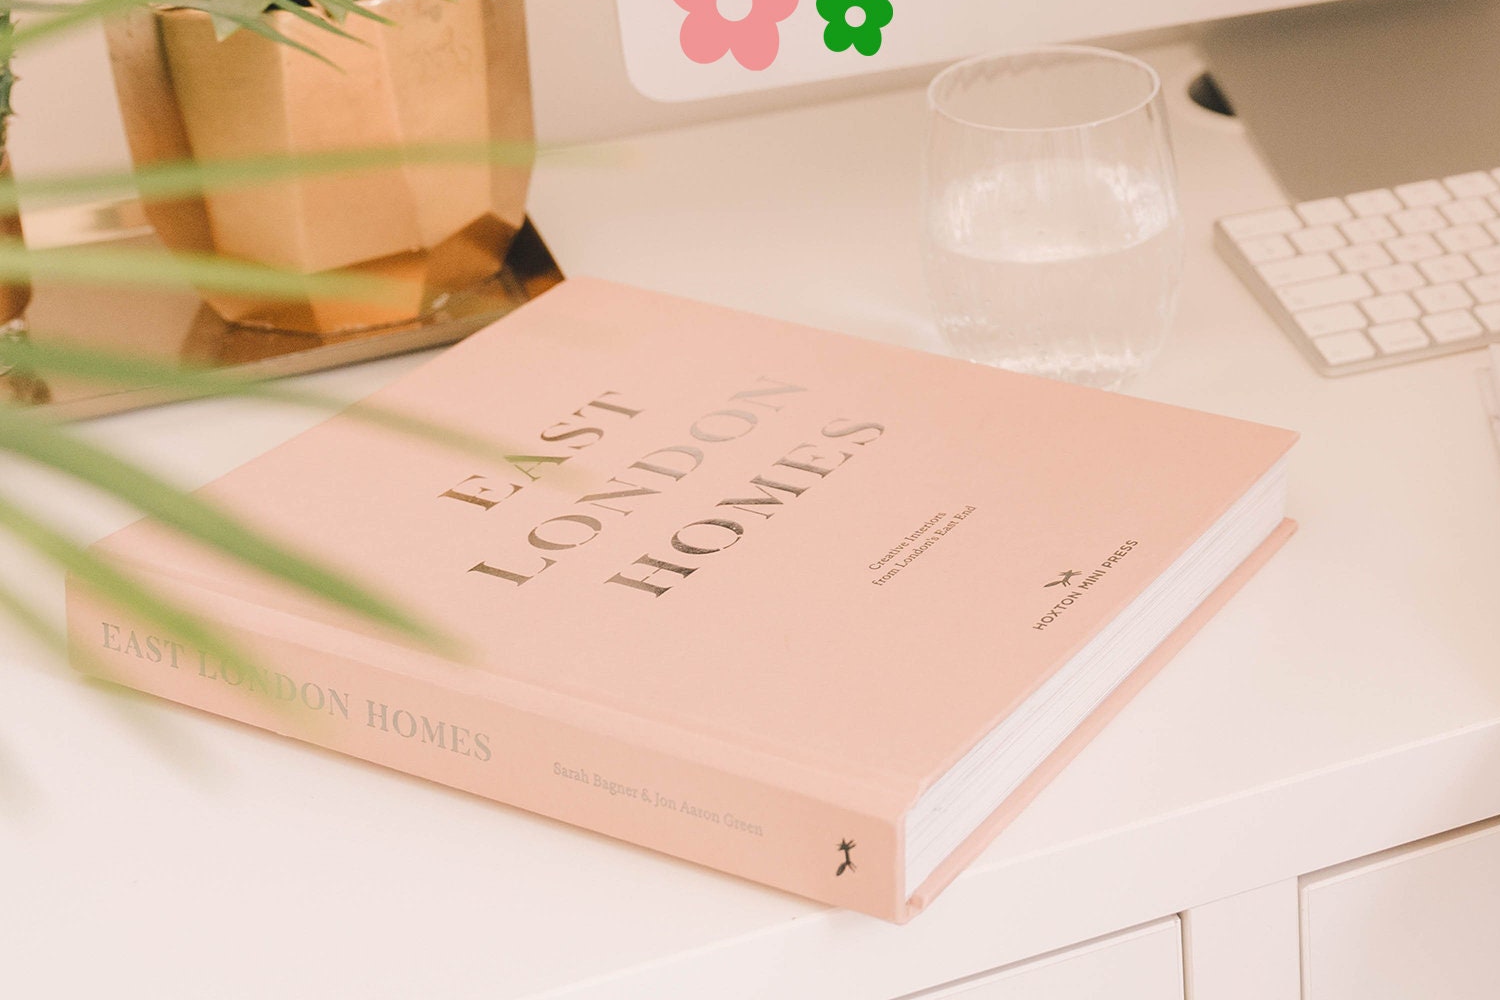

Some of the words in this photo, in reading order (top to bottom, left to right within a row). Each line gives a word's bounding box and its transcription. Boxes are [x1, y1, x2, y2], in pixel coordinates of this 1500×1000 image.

[438, 391, 644, 511] EAST
[468, 375, 808, 587] LONDON
[604, 417, 885, 598] HOMES
[868, 541, 910, 571] Creative
[904, 512, 947, 542] Interiors
[871, 568, 900, 586] from
[934, 520, 959, 536] East
[953, 505, 977, 520] End
[1032, 591, 1082, 630] HOXTON
[1077, 569, 1106, 590] MINI
[1101, 540, 1139, 569] PRESS
[101, 622, 184, 669] EAST
[198, 649, 349, 719] LONDON
[366, 699, 493, 762] HOMES
[553, 762, 590, 784] Sarah
[593, 773, 639, 798] Bagner
[640, 788, 653, 803] &
[654, 792, 677, 811] Jon
[679, 801, 721, 824] Aaron
[723, 812, 764, 837] Green
